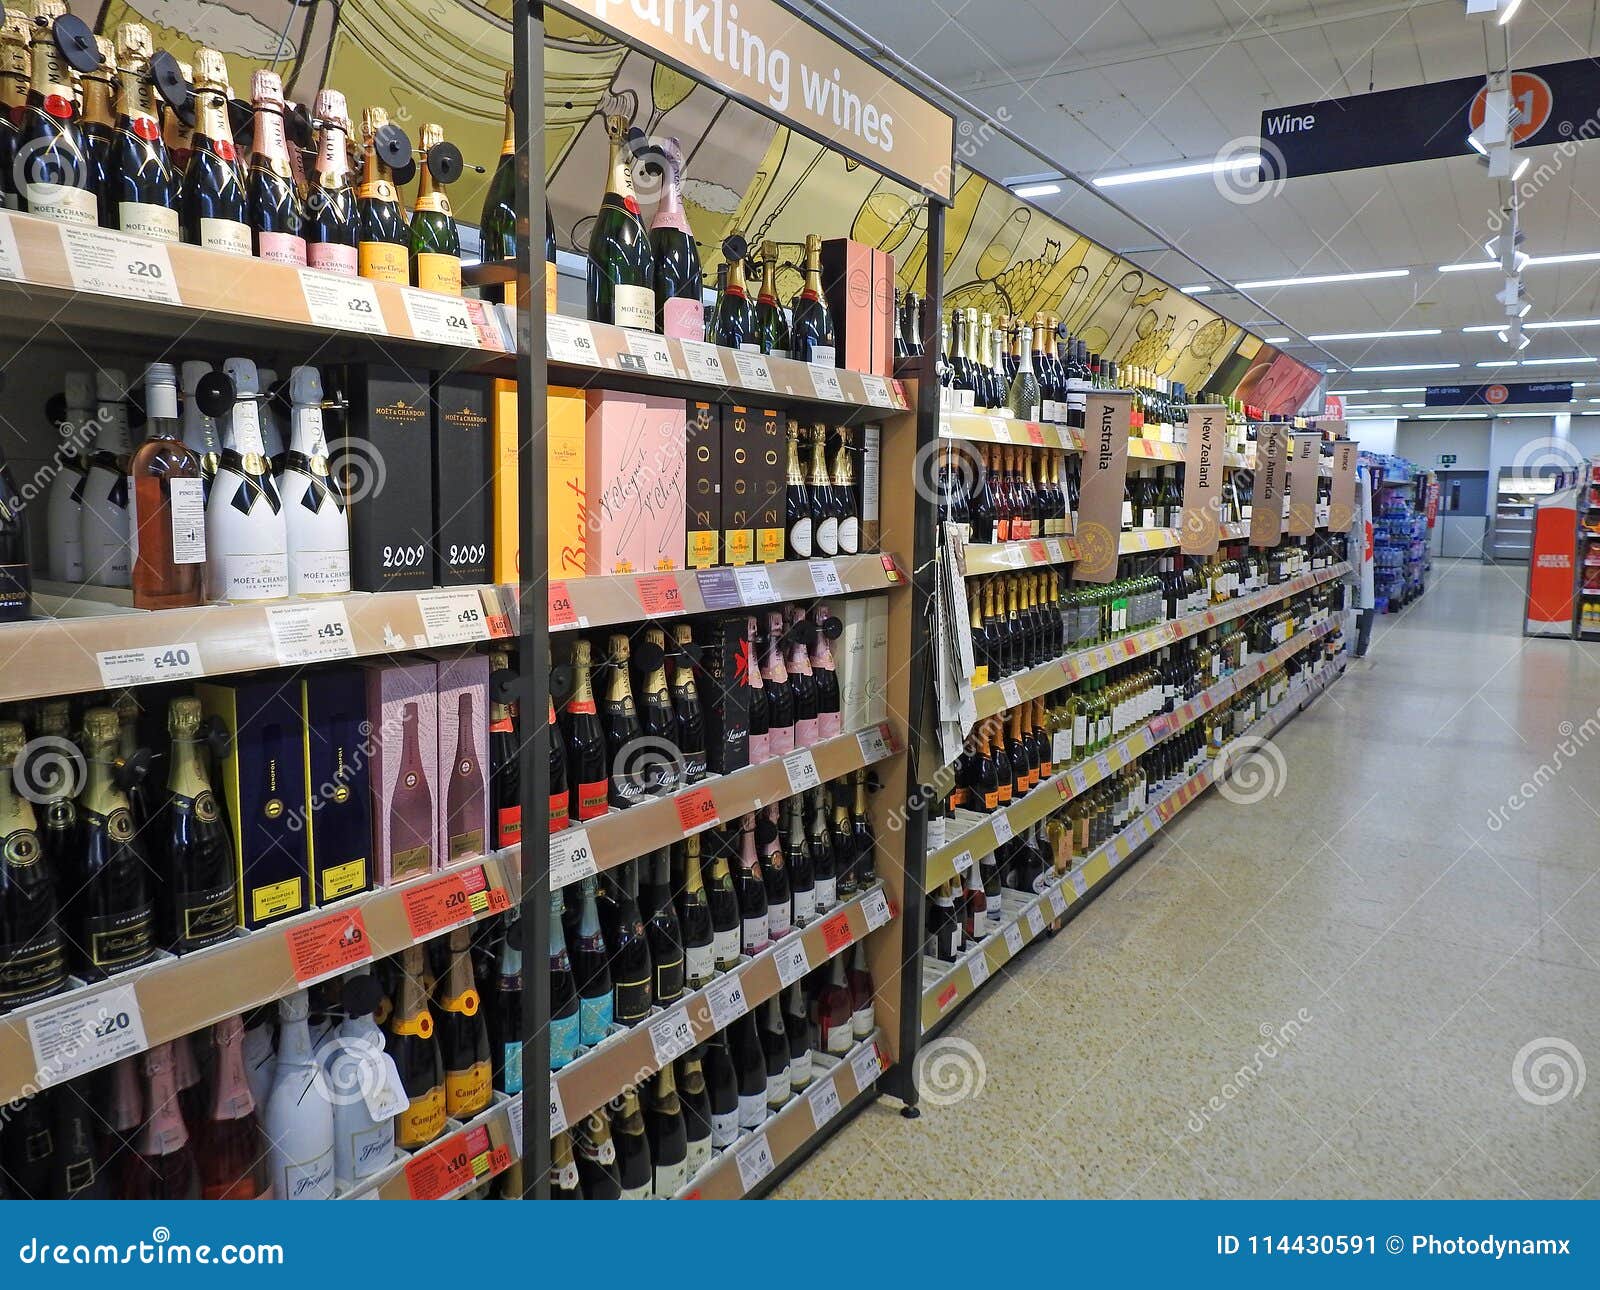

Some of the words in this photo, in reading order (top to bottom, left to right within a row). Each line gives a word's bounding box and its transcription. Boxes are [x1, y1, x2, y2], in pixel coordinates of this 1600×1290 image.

[595, 0, 790, 112] rkling
[800, 64, 895, 153] wines
[1267, 112, 1316, 136] Wine
[128, 260, 162, 280] £20
[348, 298, 373, 314] £23
[446, 315, 469, 330] £24
[574, 336, 591, 350] £85
[653, 350, 669, 363] £74
[705, 356, 719, 368] £70
[397, 409, 426, 418] CHANDON
[1201, 417, 1213, 442] New
[1098, 404, 1115, 471] Australia
[1300, 441, 1312, 459] Italy
[1198, 444, 1212, 488] Zealand
[1264, 461, 1275, 500] America
[383, 545, 425, 568] 2009
[449, 543, 485, 566] 2009
[233, 577, 256, 585] MOËT
[262, 575, 288, 584] CHANDO
[303, 571, 324, 580] MOËT
[665, 588, 679, 600] £37
[553, 599, 571, 612] £34
[457, 608, 479, 623] £45
[318, 622, 344, 638] £45
[153, 649, 190, 669] £40
[727, 728, 748, 745] Lanson
[701, 799, 715, 813] £24
[570, 847, 587, 863] £30
[329, 871, 360, 884] MONOPOLE
[261, 890, 295, 904] MONOPOLE
[445, 891, 466, 908] £20
[792, 953, 804, 966] £21
[728, 990, 741, 1004] £18
[95, 1012, 130, 1038] £20
[455, 1085, 478, 1098] Campo
[411, 1111, 435, 1126] Campo
[448, 1153, 467, 1174] £10
[759, 1151, 767, 1164] £6
